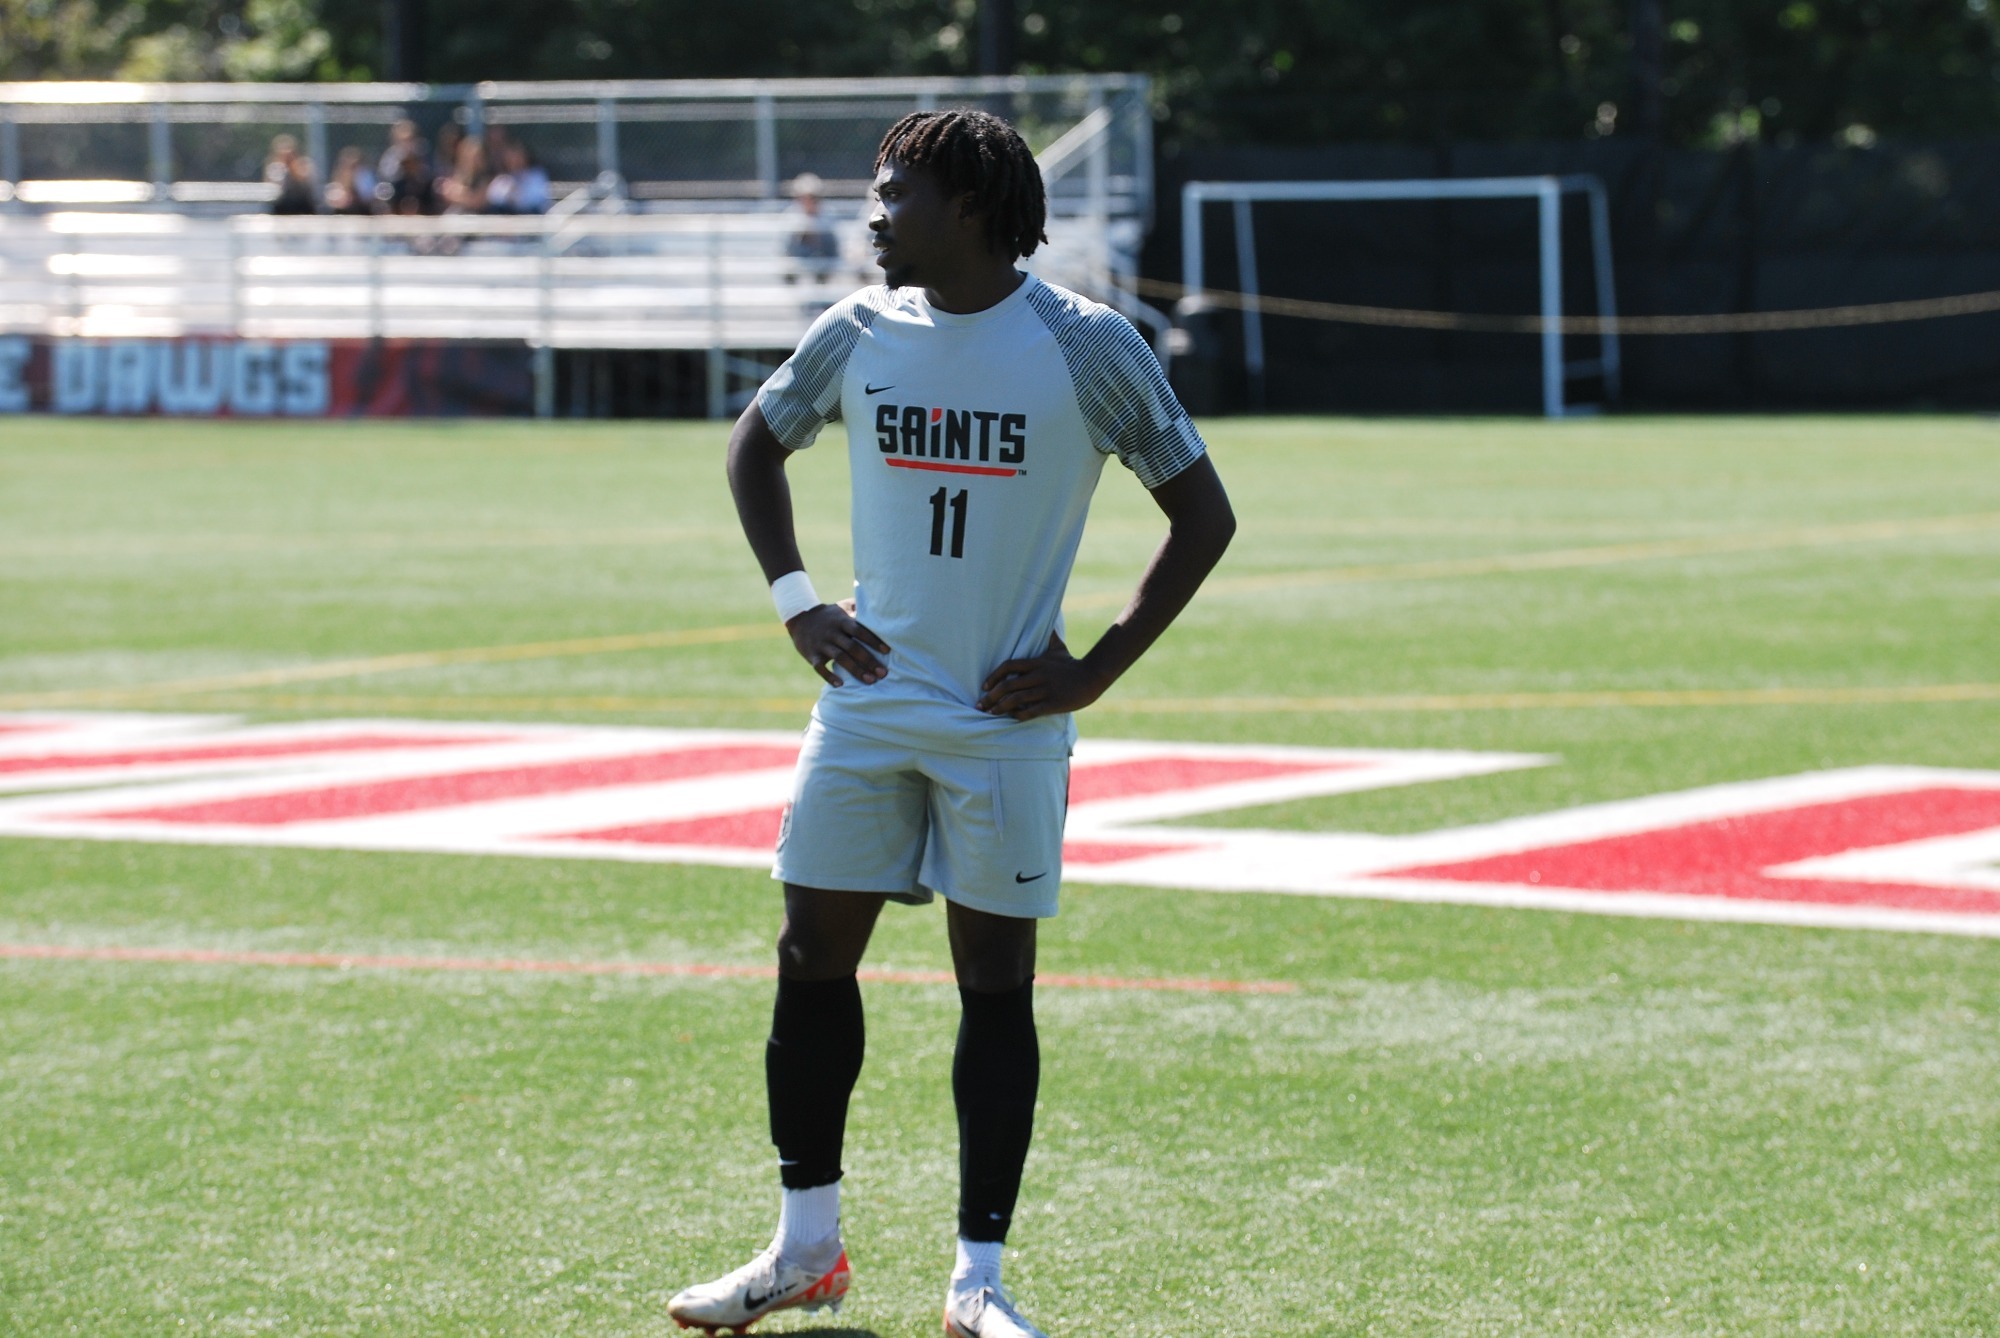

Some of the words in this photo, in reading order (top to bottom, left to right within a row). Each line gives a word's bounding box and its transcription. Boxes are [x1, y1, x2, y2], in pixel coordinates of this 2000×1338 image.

[54, 339, 329, 414] DAWGS
[876, 404, 1026, 463] SAINTS
[929, 486, 968, 559] 11
